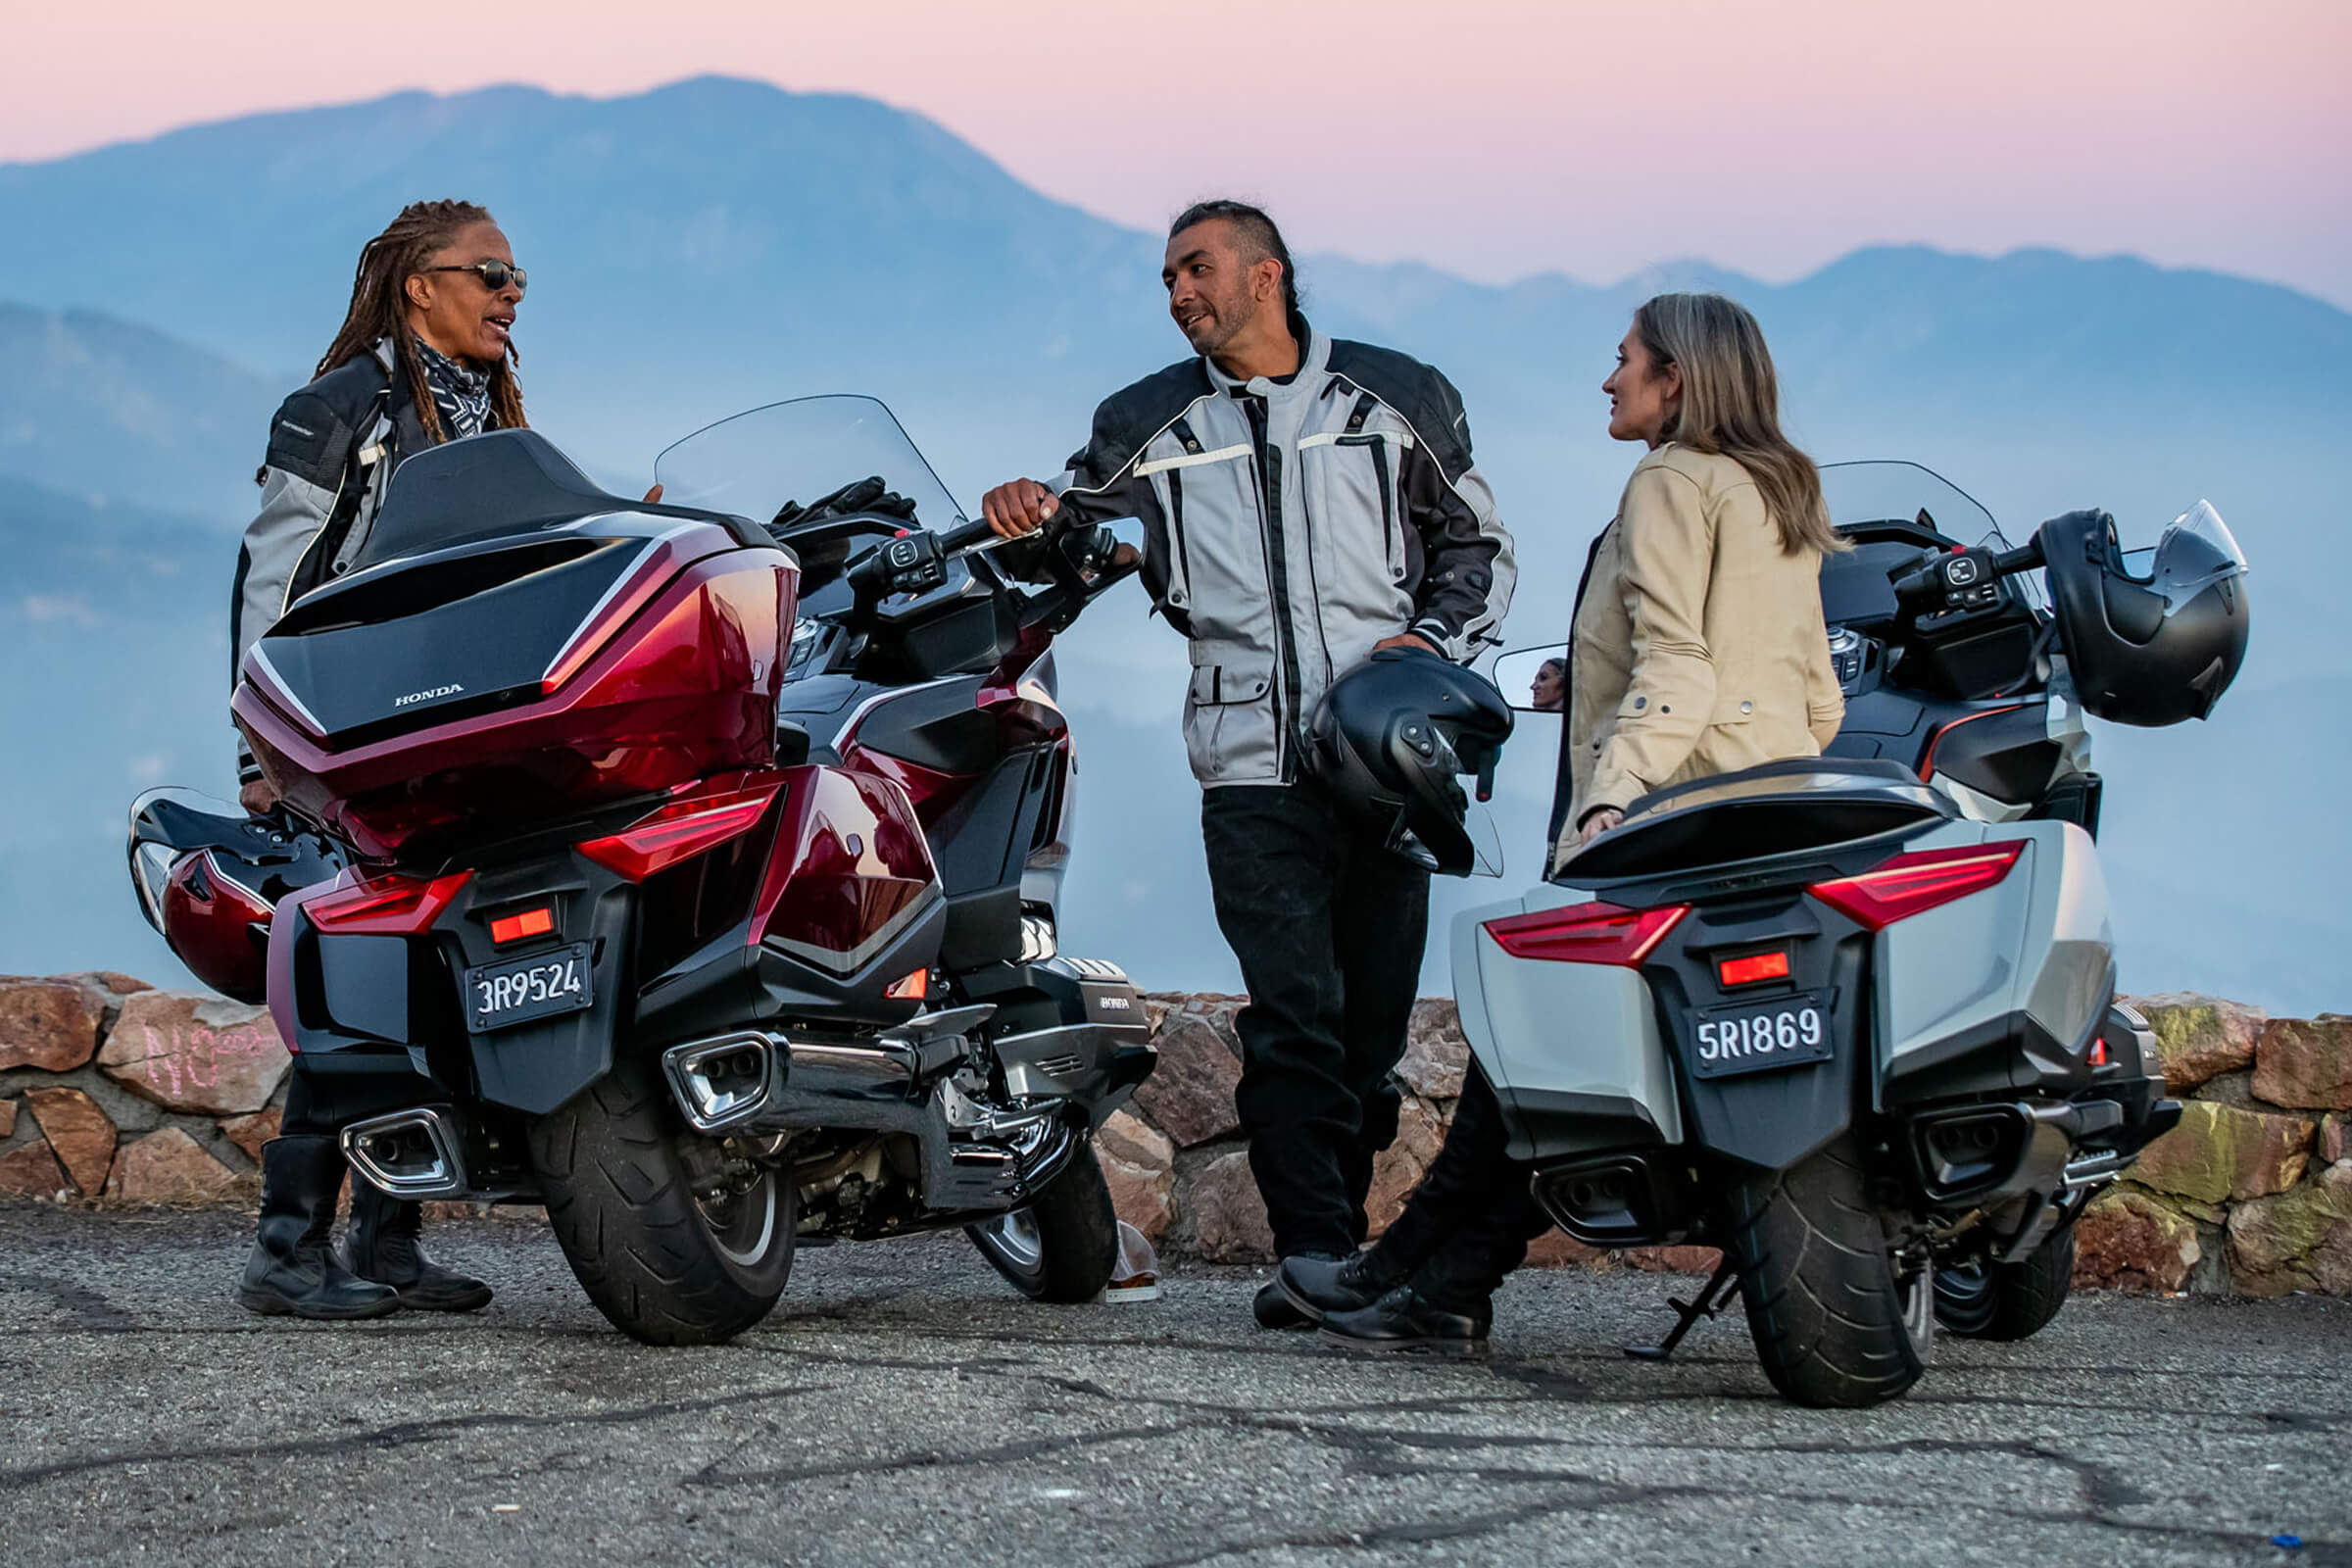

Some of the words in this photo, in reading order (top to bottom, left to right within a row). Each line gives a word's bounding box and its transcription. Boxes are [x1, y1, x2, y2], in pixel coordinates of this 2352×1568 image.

[394, 684, 465, 707] HONDA
[477, 959, 581, 1013] 3R9524
[1697, 1007, 1822, 1059] 5R1869
